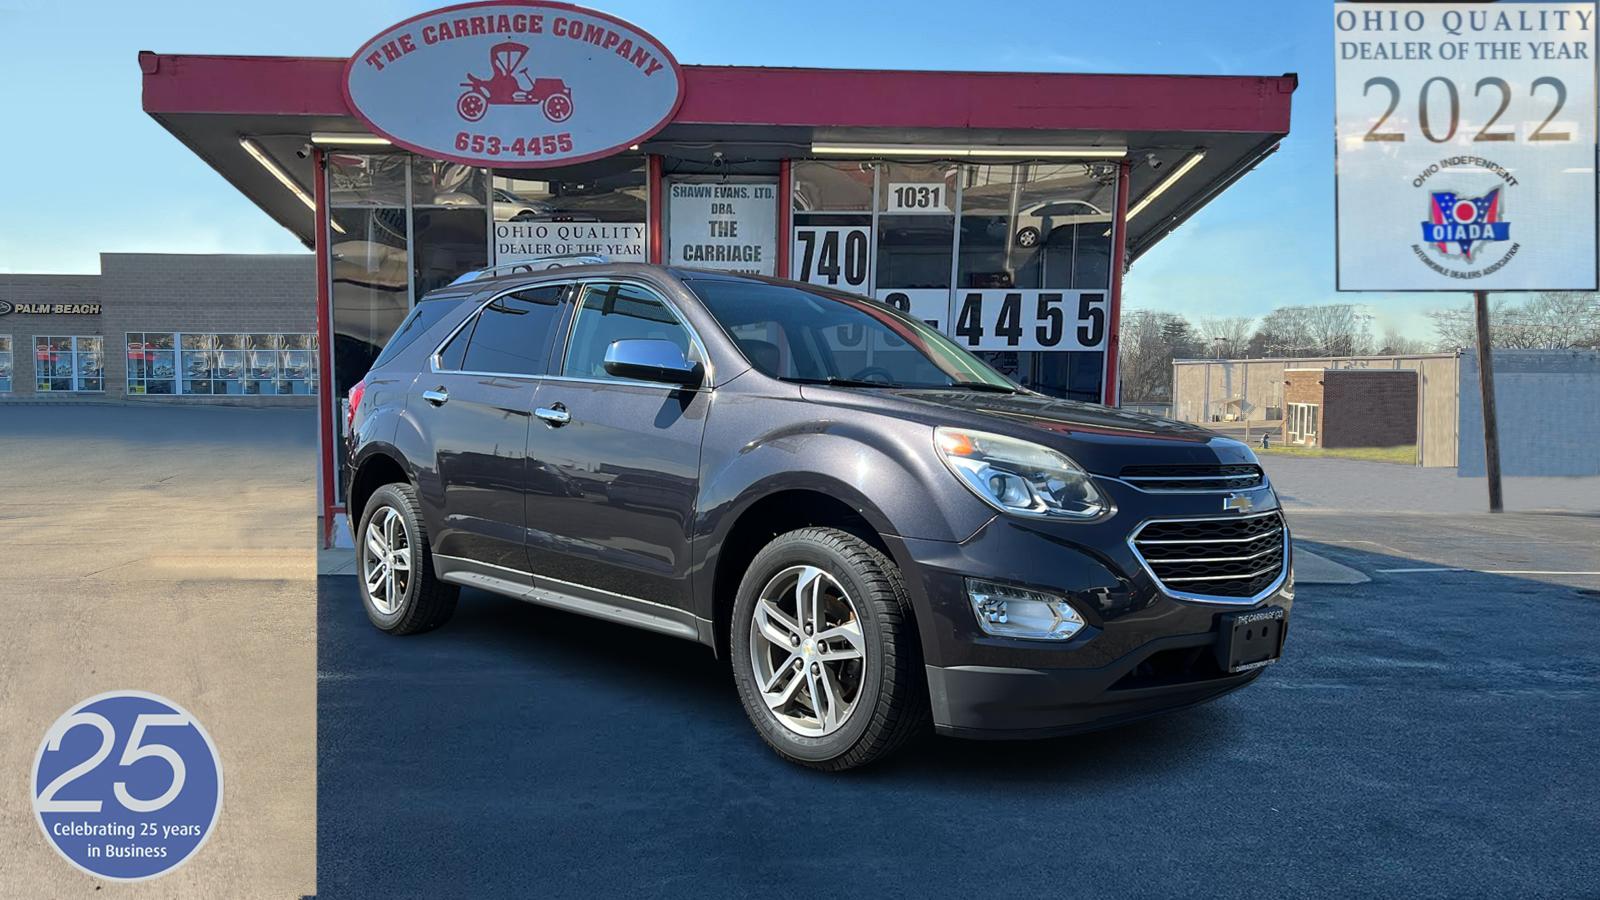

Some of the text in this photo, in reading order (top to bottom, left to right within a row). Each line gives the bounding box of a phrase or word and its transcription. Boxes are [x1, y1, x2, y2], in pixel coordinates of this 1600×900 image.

[1336, 10, 1592, 36] OHIO QUALITY
[365, 14, 664, 77] THE CARRIAGE COMPANY
[1340, 41, 1589, 60] DEALER OF THE YEAR
[1362, 76, 1571, 143] 2022
[454, 131, 573, 156] 653-4455
[1412, 155, 1519, 188] OHIO INDEPENDENT
[673, 187, 712, 198] SHAWN
[754, 187, 775, 199] LTD.
[895, 187, 940, 208] 1031
[711, 204, 736, 215] DBA.
[497, 226, 643, 241] OHIO QUALITY
[709, 221, 738, 237] THE
[1432, 225, 1495, 241] OIADA
[500, 245, 641, 256] DEALER OF THE YEAR
[683, 245, 762, 262] CARRIAGE
[797, 230, 868, 286] 740
[14, 303, 101, 314] PALM BEACH
[1238, 615, 1248, 625] THE
